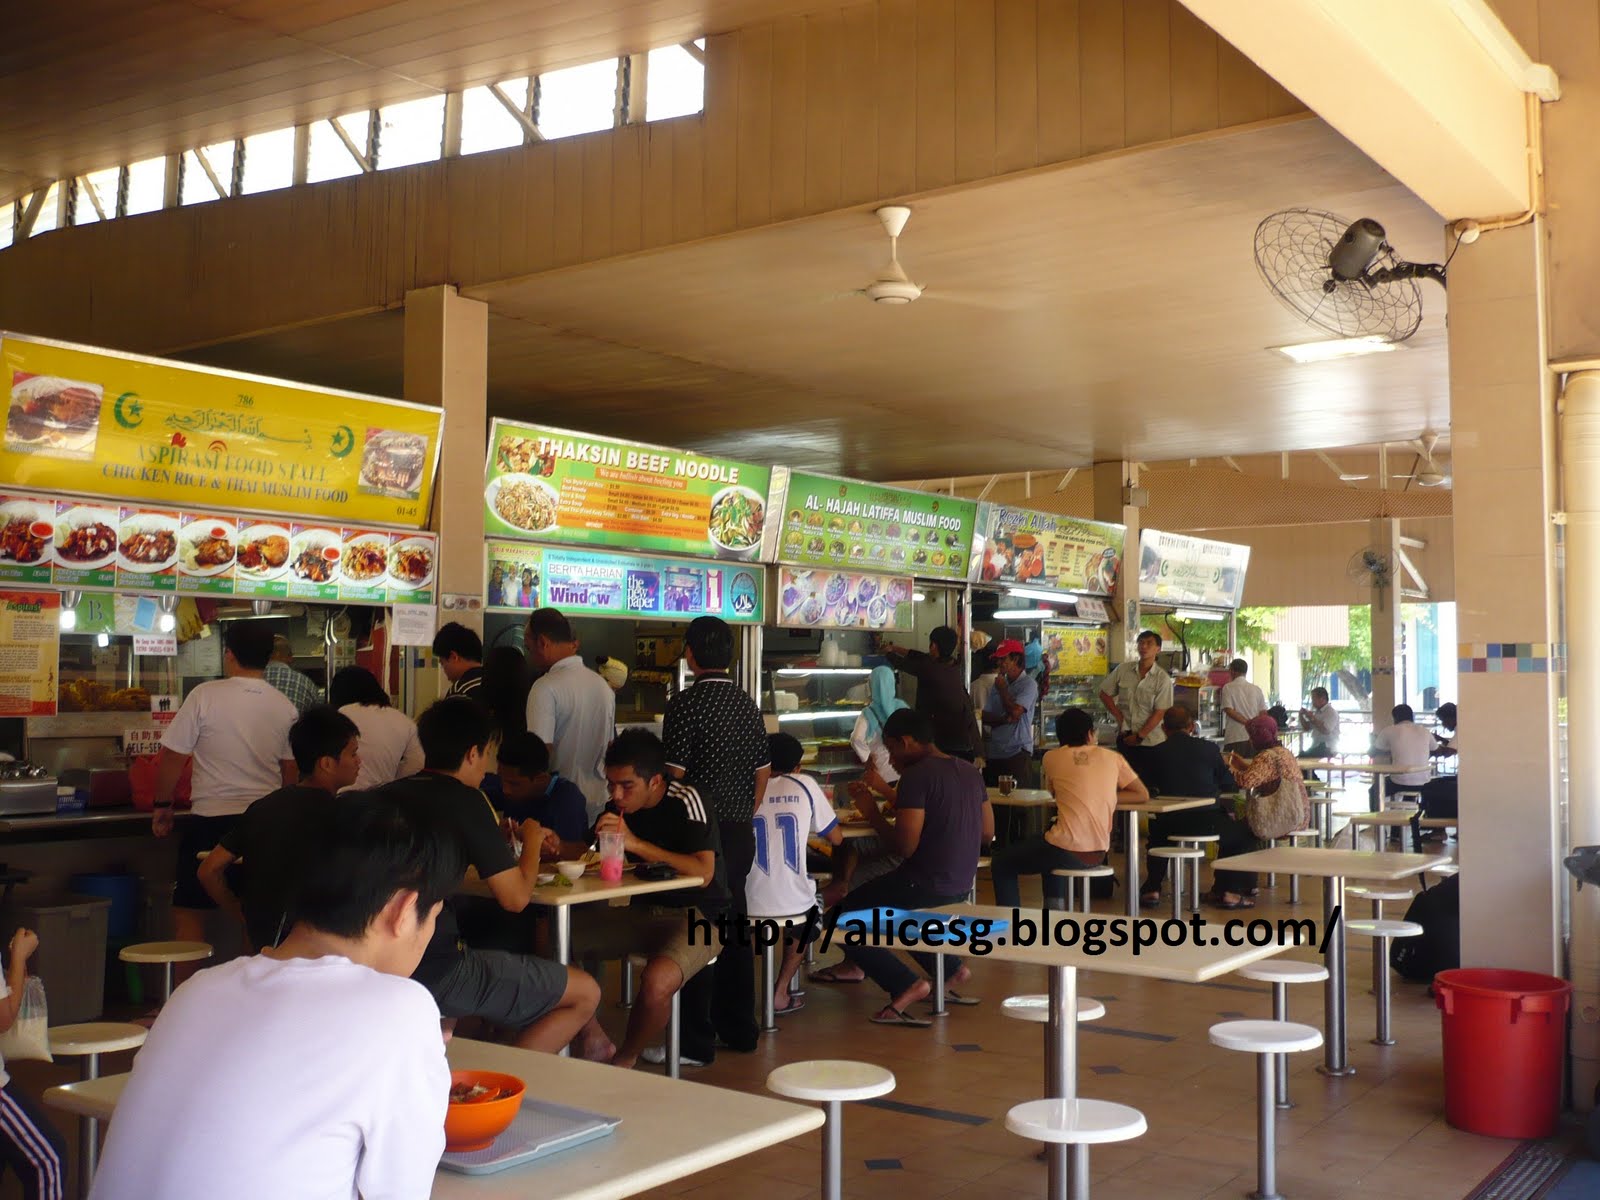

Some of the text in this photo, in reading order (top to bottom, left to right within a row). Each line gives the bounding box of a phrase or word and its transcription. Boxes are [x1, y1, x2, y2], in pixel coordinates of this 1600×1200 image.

[238, 395, 254, 406] 786
[137, 444, 326, 482] ASPIRASI FOOD STALL
[538, 437, 740, 484] THAKSIN BEEF NOODLE
[103, 464, 348, 503] CHICKEN RICE & THAI MUSLIM FOOD
[805, 495, 823, 511] AL-
[825, 498, 861, 517] HAJAH
[862, 503, 900, 522] LATIFFA
[902, 510, 937, 529] MUSLIM
[938, 515, 961, 532] FOOD
[1030, 515, 1057, 532] Allah
[549, 563, 583, 575] BERITA
[585, 565, 623, 578] HARIAN
[628, 574, 644, 588] the
[550, 587, 610, 605] Window
[627, 588, 648, 598] new
[627, 596, 655, 611] paper
[130, 730, 162, 741] 自助服
[752, 812, 800, 877] 11
